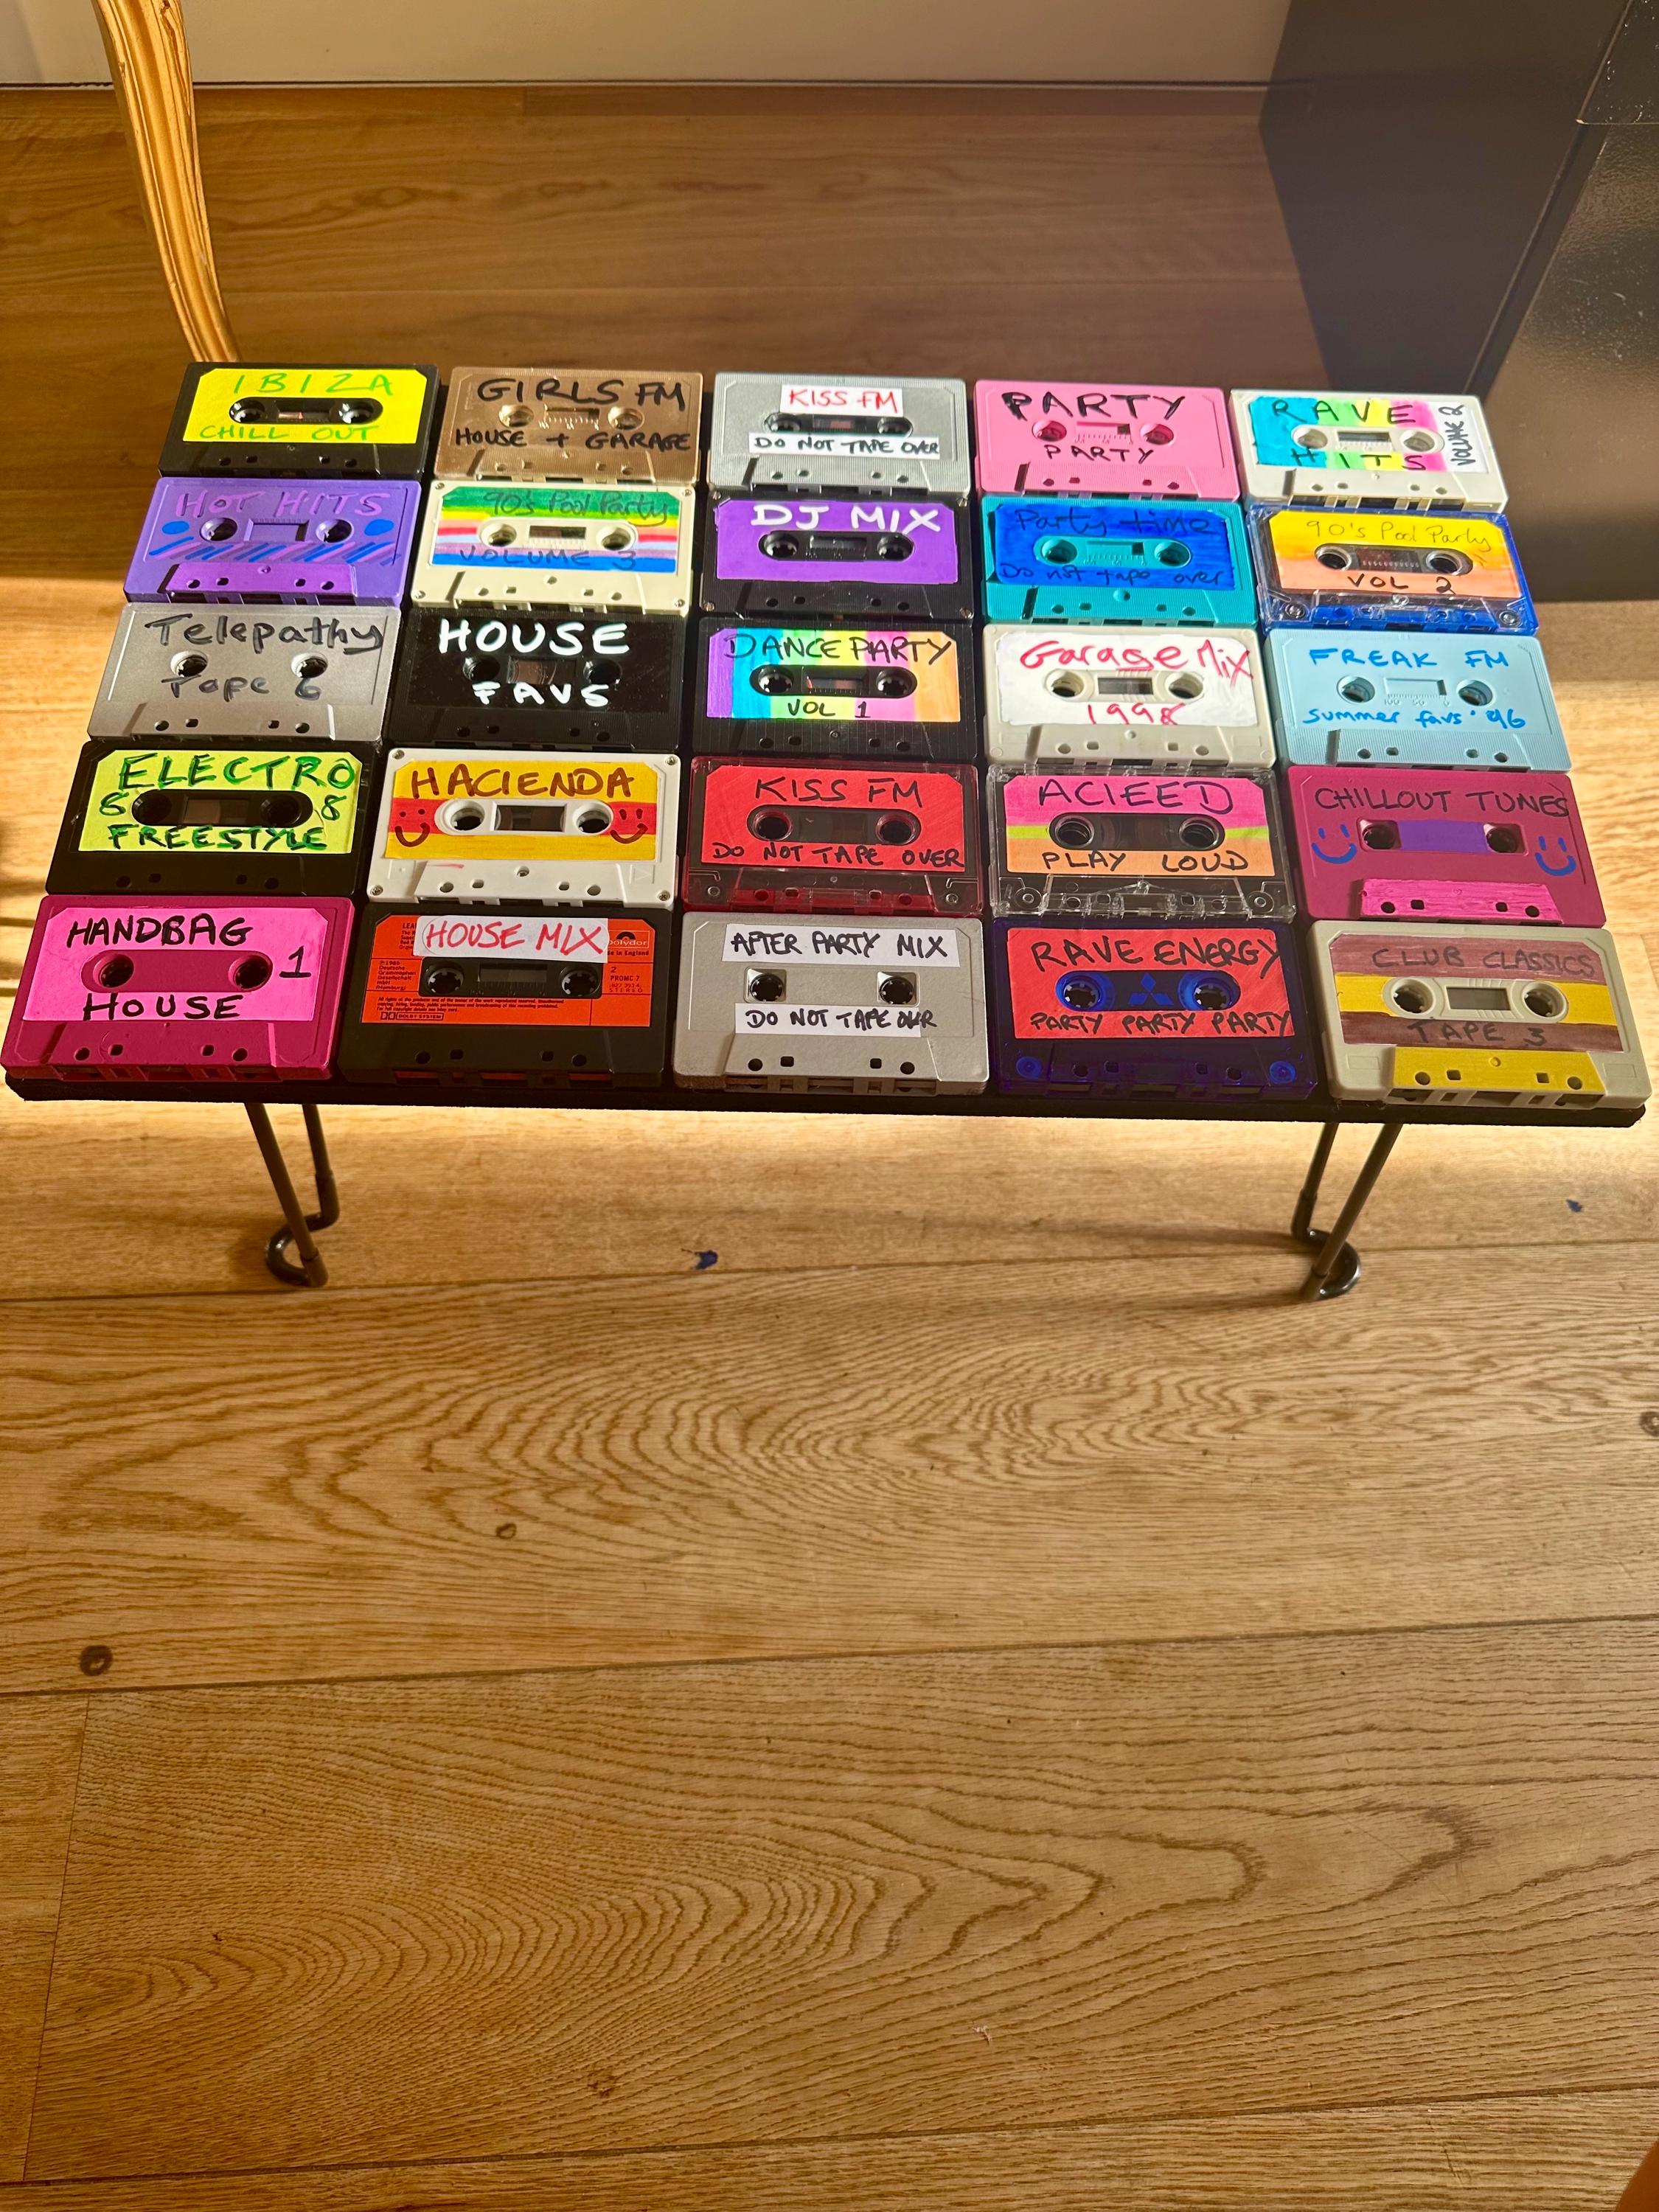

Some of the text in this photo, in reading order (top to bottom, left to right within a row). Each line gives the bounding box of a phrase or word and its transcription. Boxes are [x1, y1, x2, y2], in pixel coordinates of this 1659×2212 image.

[234, 373, 393, 395] IBIZA
[477, 378, 625, 404] GIRLS
[635, 382, 685, 411] FM
[789, 389, 898, 414] KISS FM
[1001, 391, 1186, 421] PARTY
[1272, 399, 1416, 425] RAVE
[200, 425, 379, 441] CHILL OUT
[456, 428, 690, 452] HOUSE + GARAGE
[754, 437, 939, 454] DO NOT TAPE OVER
[1444, 421, 1476, 466] VOLUME
[1043, 444, 1154, 464] PARTY
[1290, 448, 1427, 471] HITS
[274, 489, 391, 517] HITS
[483, 490, 668, 526] 90's Pool Party
[751, 504, 941, 535] DJ MIX
[1015, 507, 1107, 536] Party
[1307, 521, 1492, 552] 90's Pool Party
[459, 547, 636, 571] VOLUME 3
[1000, 563, 1034, 578] Do
[1097, 567, 1151, 583] tape
[1174, 570, 1225, 585] over
[1348, 574, 1456, 594] VOL 2
[145, 613, 384, 655] Telepathy
[438, 618, 630, 655] HOUSE
[723, 634, 953, 664] DANCE PARTY
[1020, 639, 1189, 672] Garage
[1309, 647, 1509, 668] FREAK FM
[161, 674, 321, 703] Tape 6
[472, 681, 610, 707] FAVS
[787, 699, 872, 719] VOL 1
[1088, 703, 1186, 725] 1998
[1416, 709, 1462, 728] favs
[118, 753, 355, 790] ELECTRO
[411, 763, 635, 799] HACIENDA
[755, 776, 922, 808] KISS FM
[1039, 779, 1234, 815] ACIEED
[1315, 787, 1570, 817] CHILLOUT TUNES
[321, 794, 347, 821] 8
[108, 824, 328, 851] FREESTYLE
[712, 841, 965, 868] DO NOT TAPE OVER
[1042, 850, 1248, 872] PLAY LOUD
[66, 913, 254, 948] HANDBAG
[426, 920, 606, 956] HOUSE MIX
[731, 931, 948, 958] AFTER PARTY MIX
[1031, 935, 1281, 979] RAVE ENERGY
[279, 945, 311, 978] 1
[1372, 946, 1596, 977] CLUB CLASSICS
[83, 992, 244, 1020] HOUSE
[745, 1008, 937, 1030] DO NOT TAPE OVER
[1030, 1011, 1290, 1037] PARTY PARTY PARTY
[1408, 1020, 1547, 1046] TAPE 3
